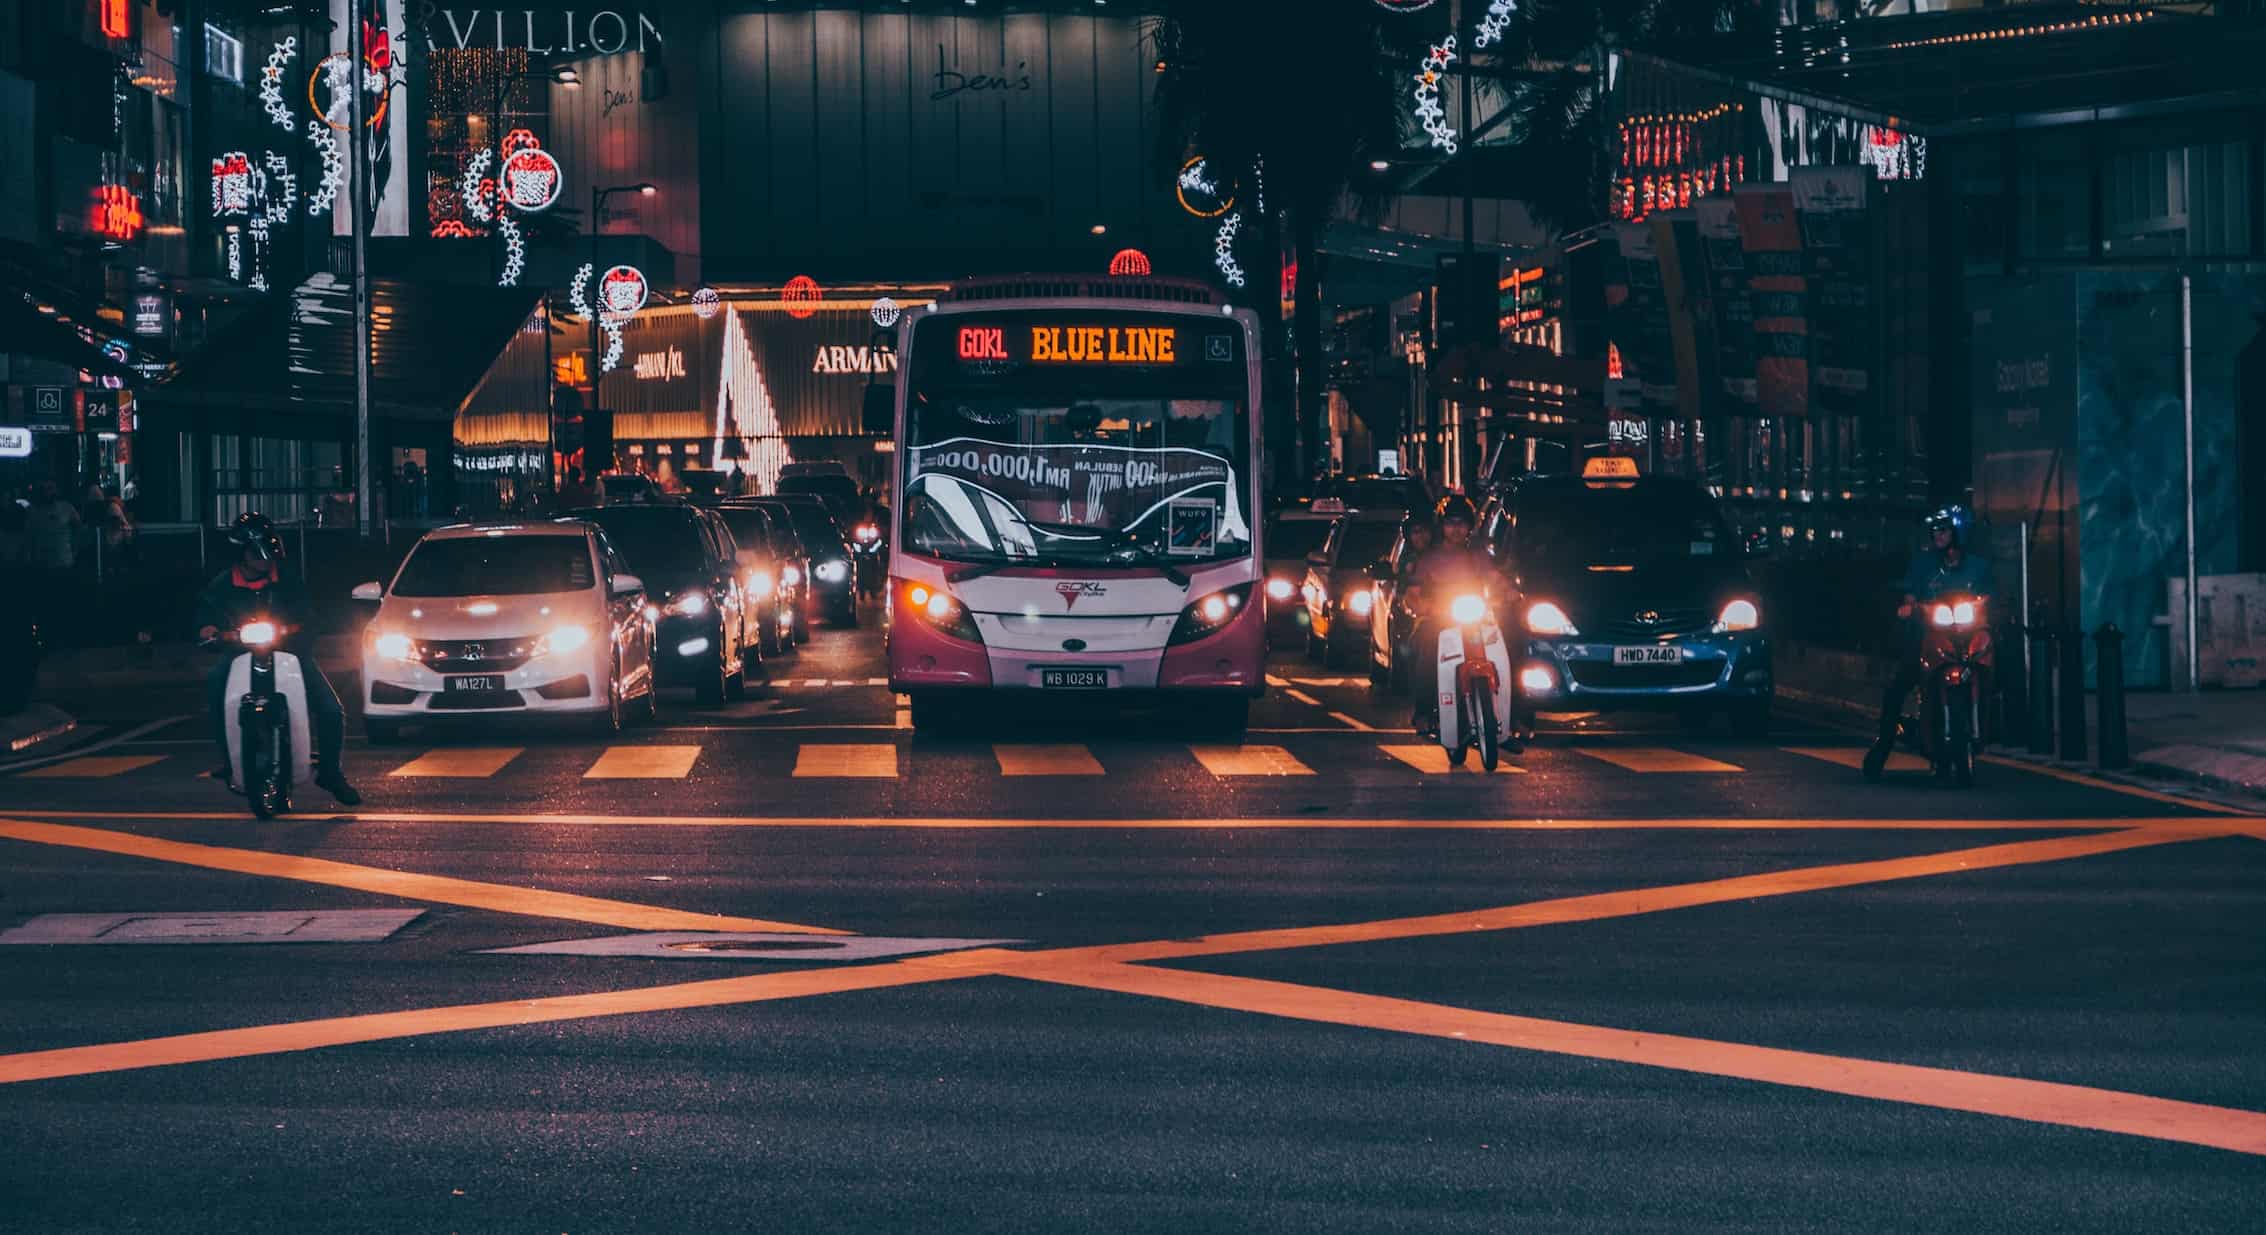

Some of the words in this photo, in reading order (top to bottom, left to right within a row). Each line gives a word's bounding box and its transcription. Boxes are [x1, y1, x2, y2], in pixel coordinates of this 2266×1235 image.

[424, 9, 663, 54] VILION
[959, 327, 1008, 359] GOKL
[1031, 327, 1104, 361] BLUE
[1108, 327, 1175, 361] LINE
[1621, 648, 1644, 661] HWD
[1647, 648, 1675, 661] 7440
[1046, 672, 1062, 685] WB
[1066, 672, 1093, 685] 1029
[1096, 672, 1105, 685] K
